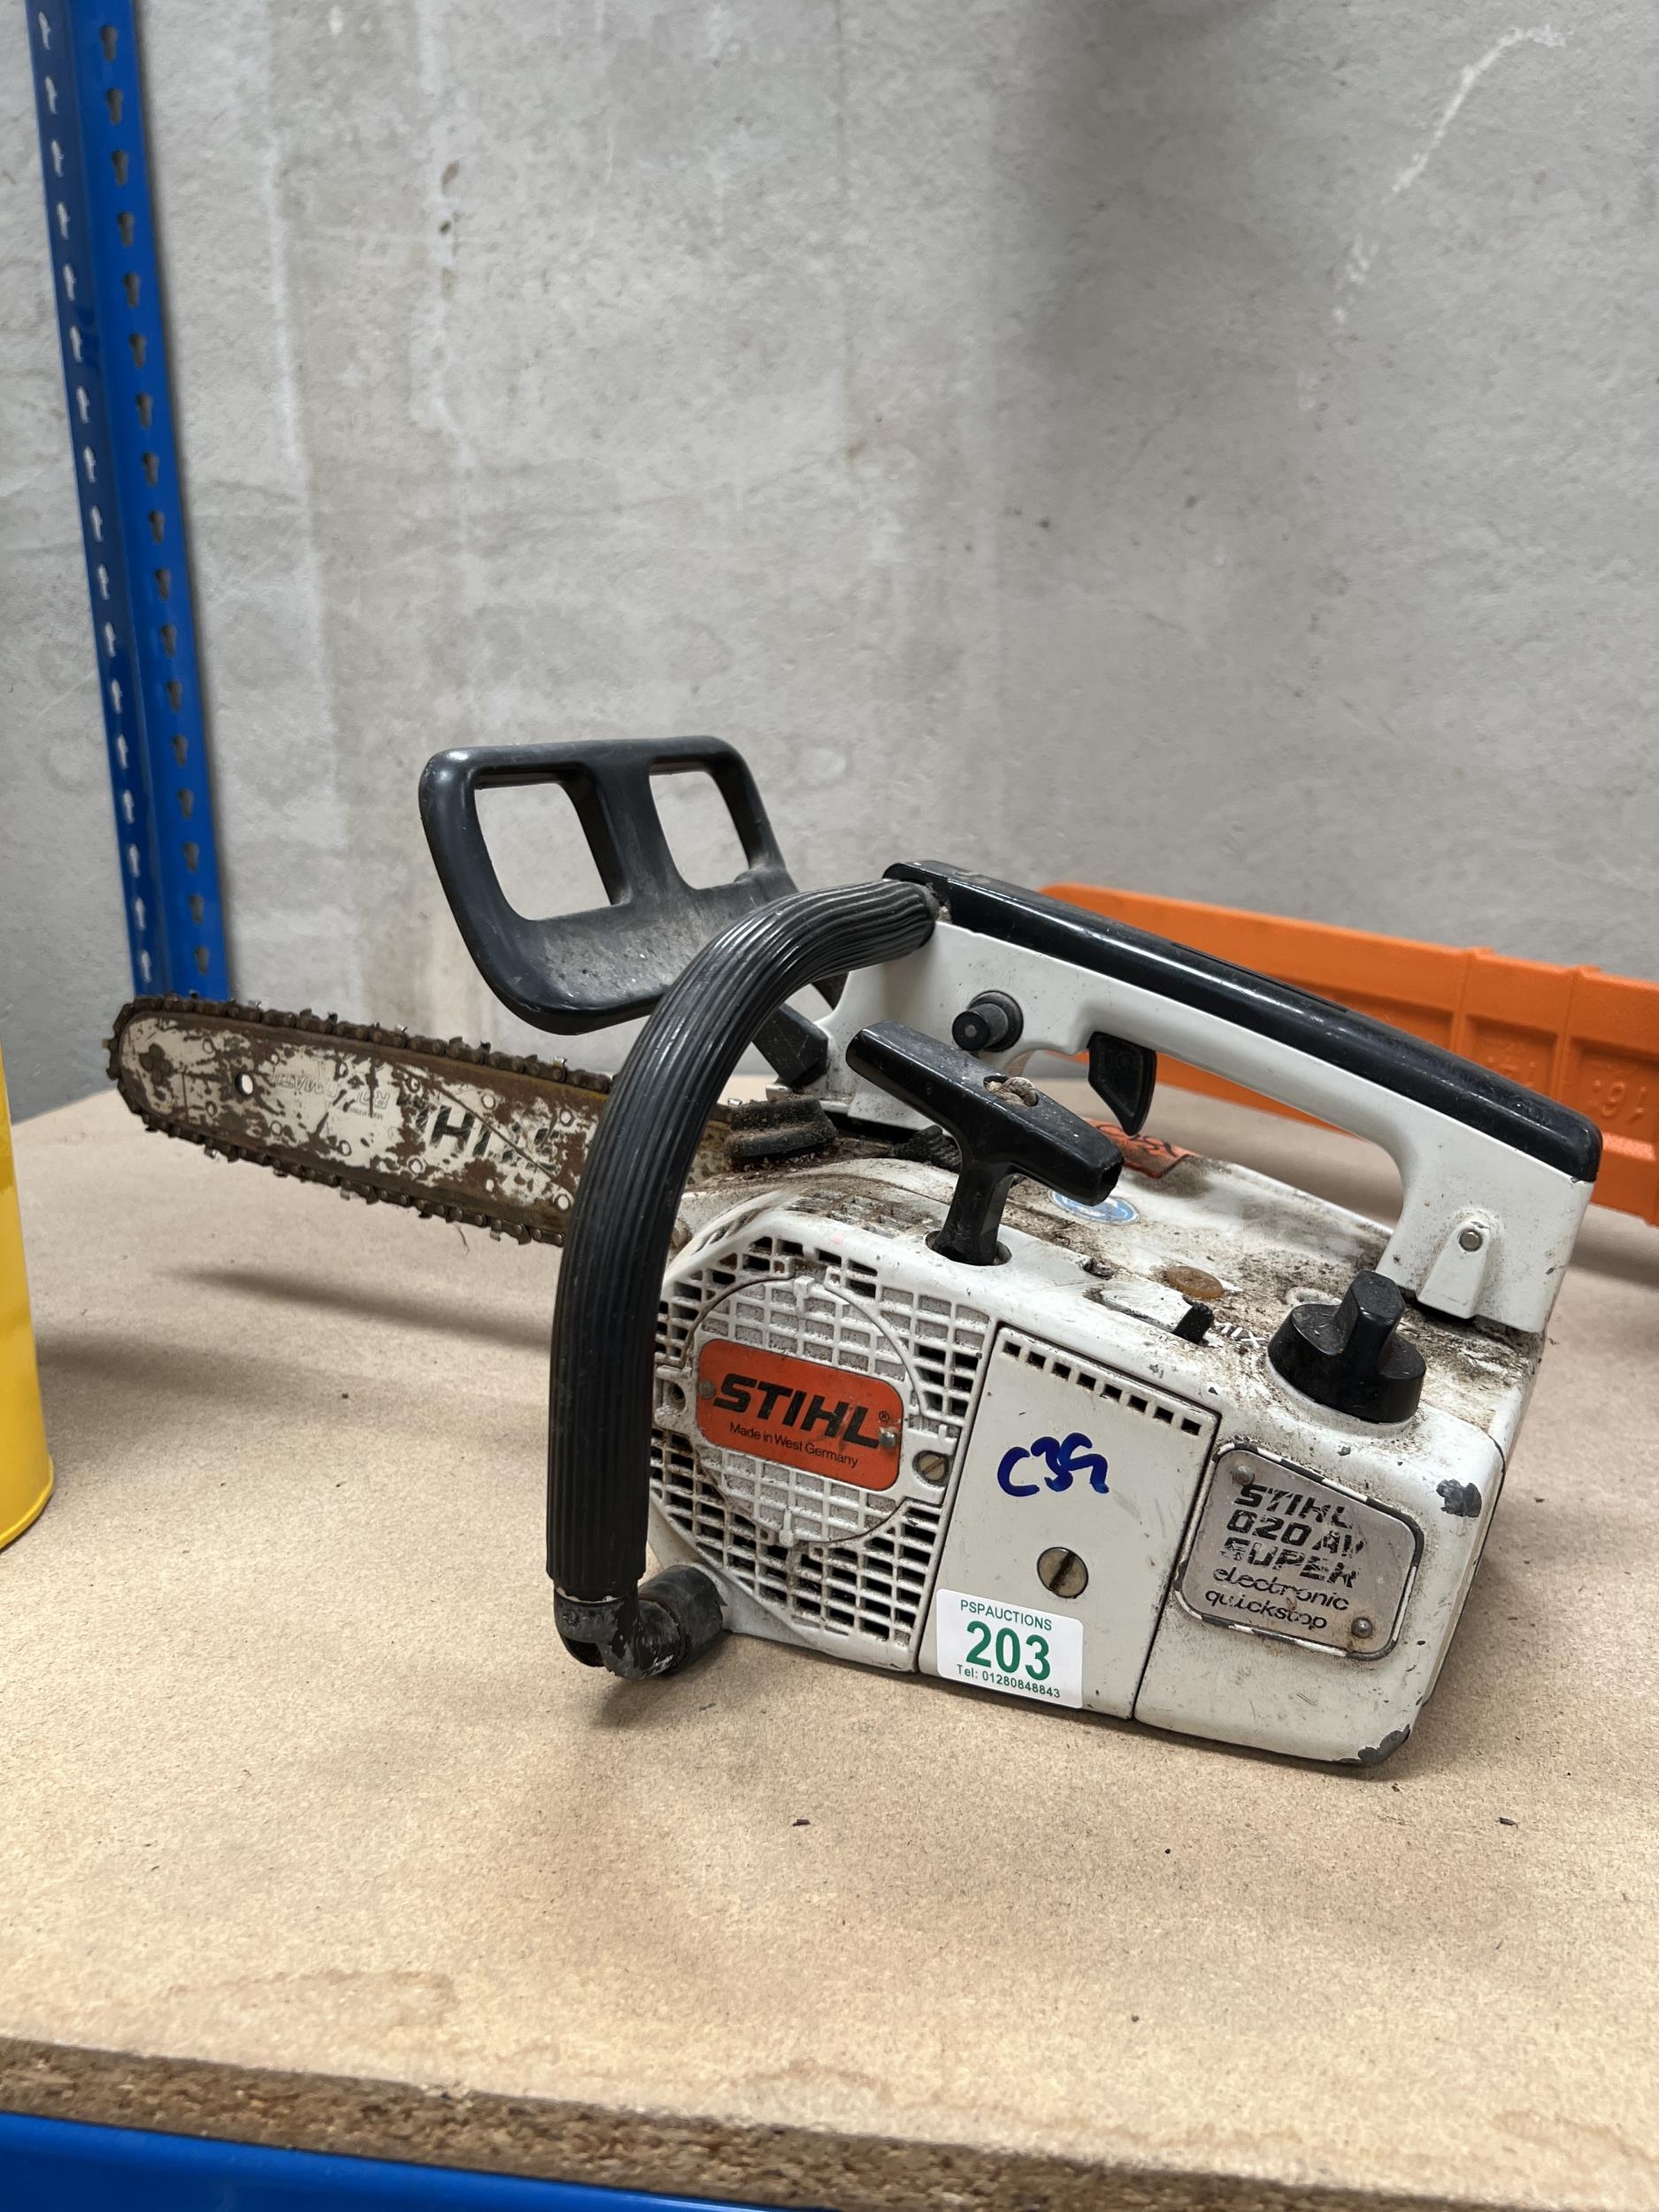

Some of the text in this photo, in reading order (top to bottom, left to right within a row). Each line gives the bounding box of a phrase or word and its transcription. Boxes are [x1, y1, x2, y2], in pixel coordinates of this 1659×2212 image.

[713, 1373, 879, 1448] STIHL
[730, 1422, 858, 1468] Made in West Germany
[1226, 1509, 1311, 1547] 020
[1234, 1484, 1353, 1529] STIHL
[1205, 1589, 1327, 1630] quickstop
[1213, 1566, 1349, 1610] electronic
[960, 1599, 1052, 1631] PSPAUCTIONS
[965, 1620, 1051, 1680] 203
[956, 1664, 1061, 1698] Tel: 01280848843
